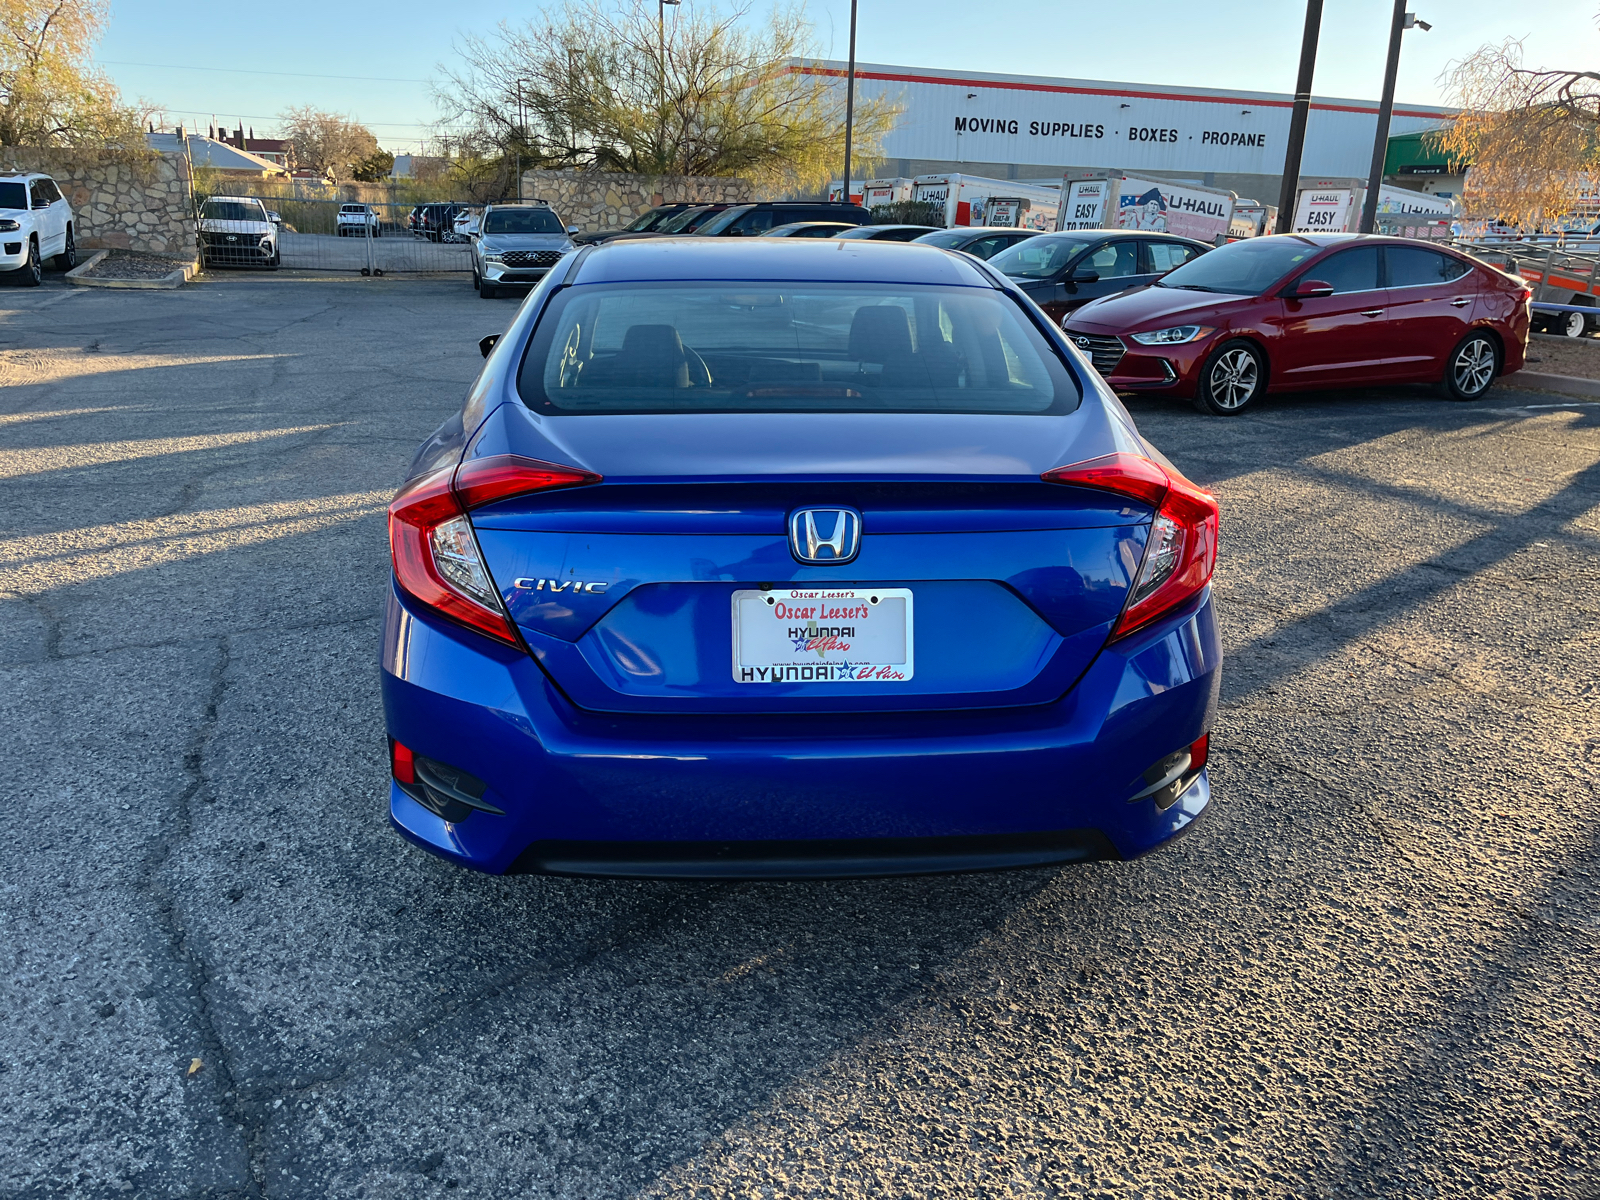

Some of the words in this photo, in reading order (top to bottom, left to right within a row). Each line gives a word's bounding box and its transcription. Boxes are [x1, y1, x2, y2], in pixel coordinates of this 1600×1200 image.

[954, 116, 1019, 135] MOVING
[1029, 121, 1105, 139] SUPPLIES
[1128, 127, 1179, 143] BOXES
[1202, 131, 1266, 147] PROPANE
[922, 190, 946, 201] U-HAU
[1079, 185, 1100, 193] U-HAUL
[1075, 203, 1098, 218] EASY
[1169, 195, 1225, 217] U-HAUL
[1307, 211, 1336, 225] EASY
[514, 577, 608, 594] CIVIC
[790, 590, 819, 599] Oscar
[821, 590, 855, 599] Leeser's
[774, 602, 816, 620] Oscar
[819, 603, 869, 619] Leeser's
[788, 627, 855, 638] HYUNDAI
[741, 666, 834, 681] HYUNDAI
[856, 666, 873, 680] El
[875, 665, 905, 680] Paso
